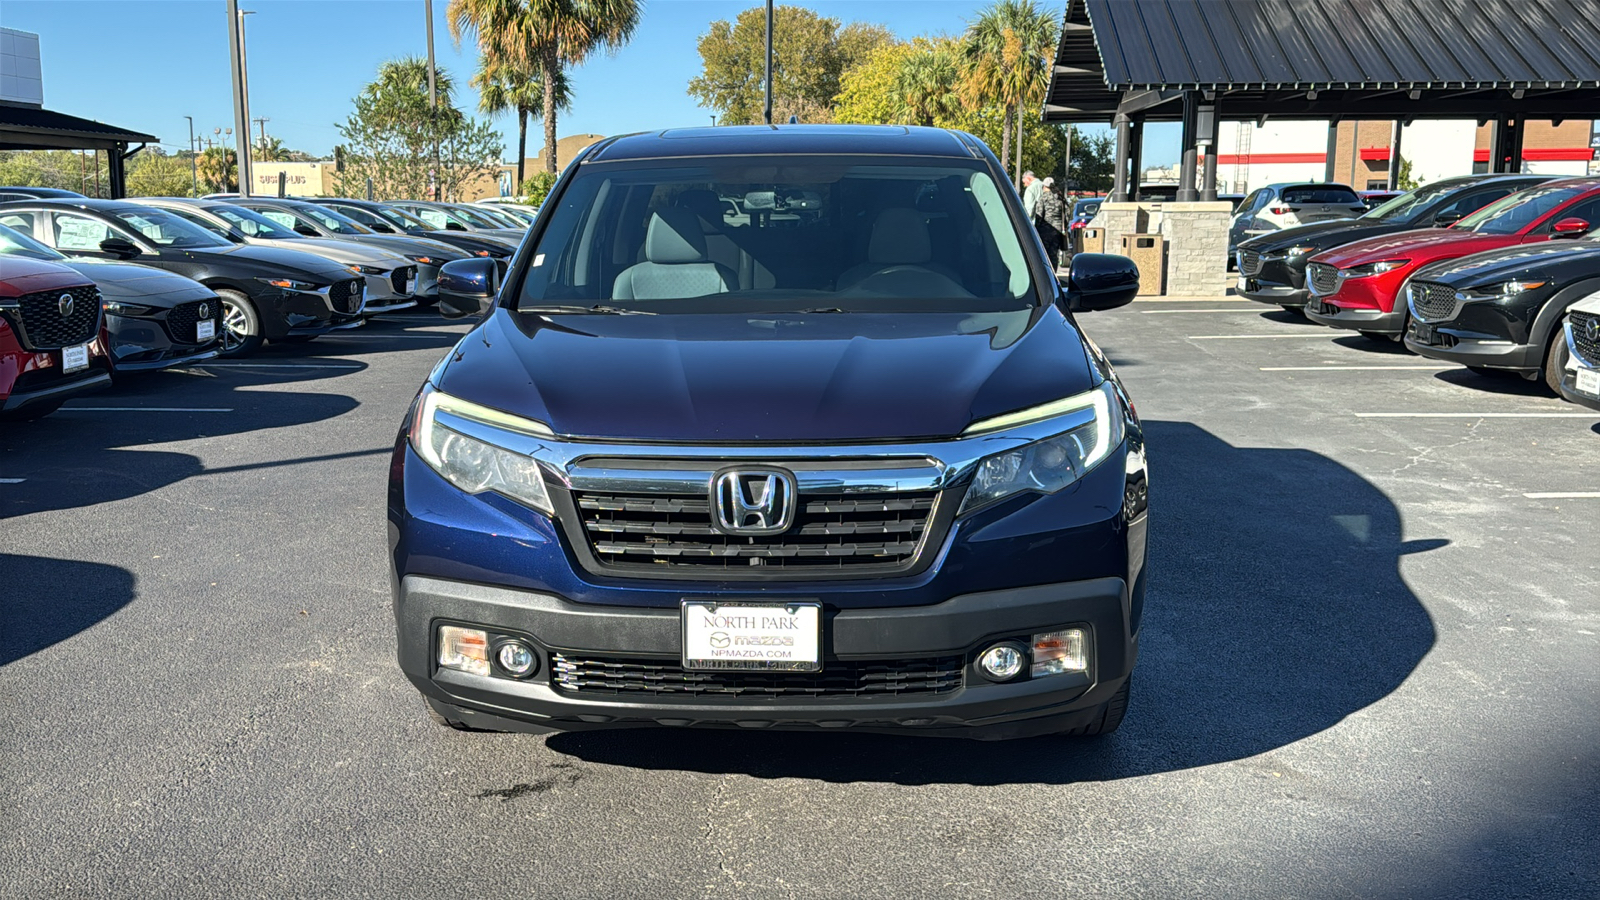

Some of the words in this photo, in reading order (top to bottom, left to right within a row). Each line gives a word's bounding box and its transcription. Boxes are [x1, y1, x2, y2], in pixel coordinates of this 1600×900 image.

[259, 175, 281, 184] SUSH
[704, 616, 755, 629] NORTH
[762, 617, 799, 629] PARK
[735, 636, 794, 646] mazda
